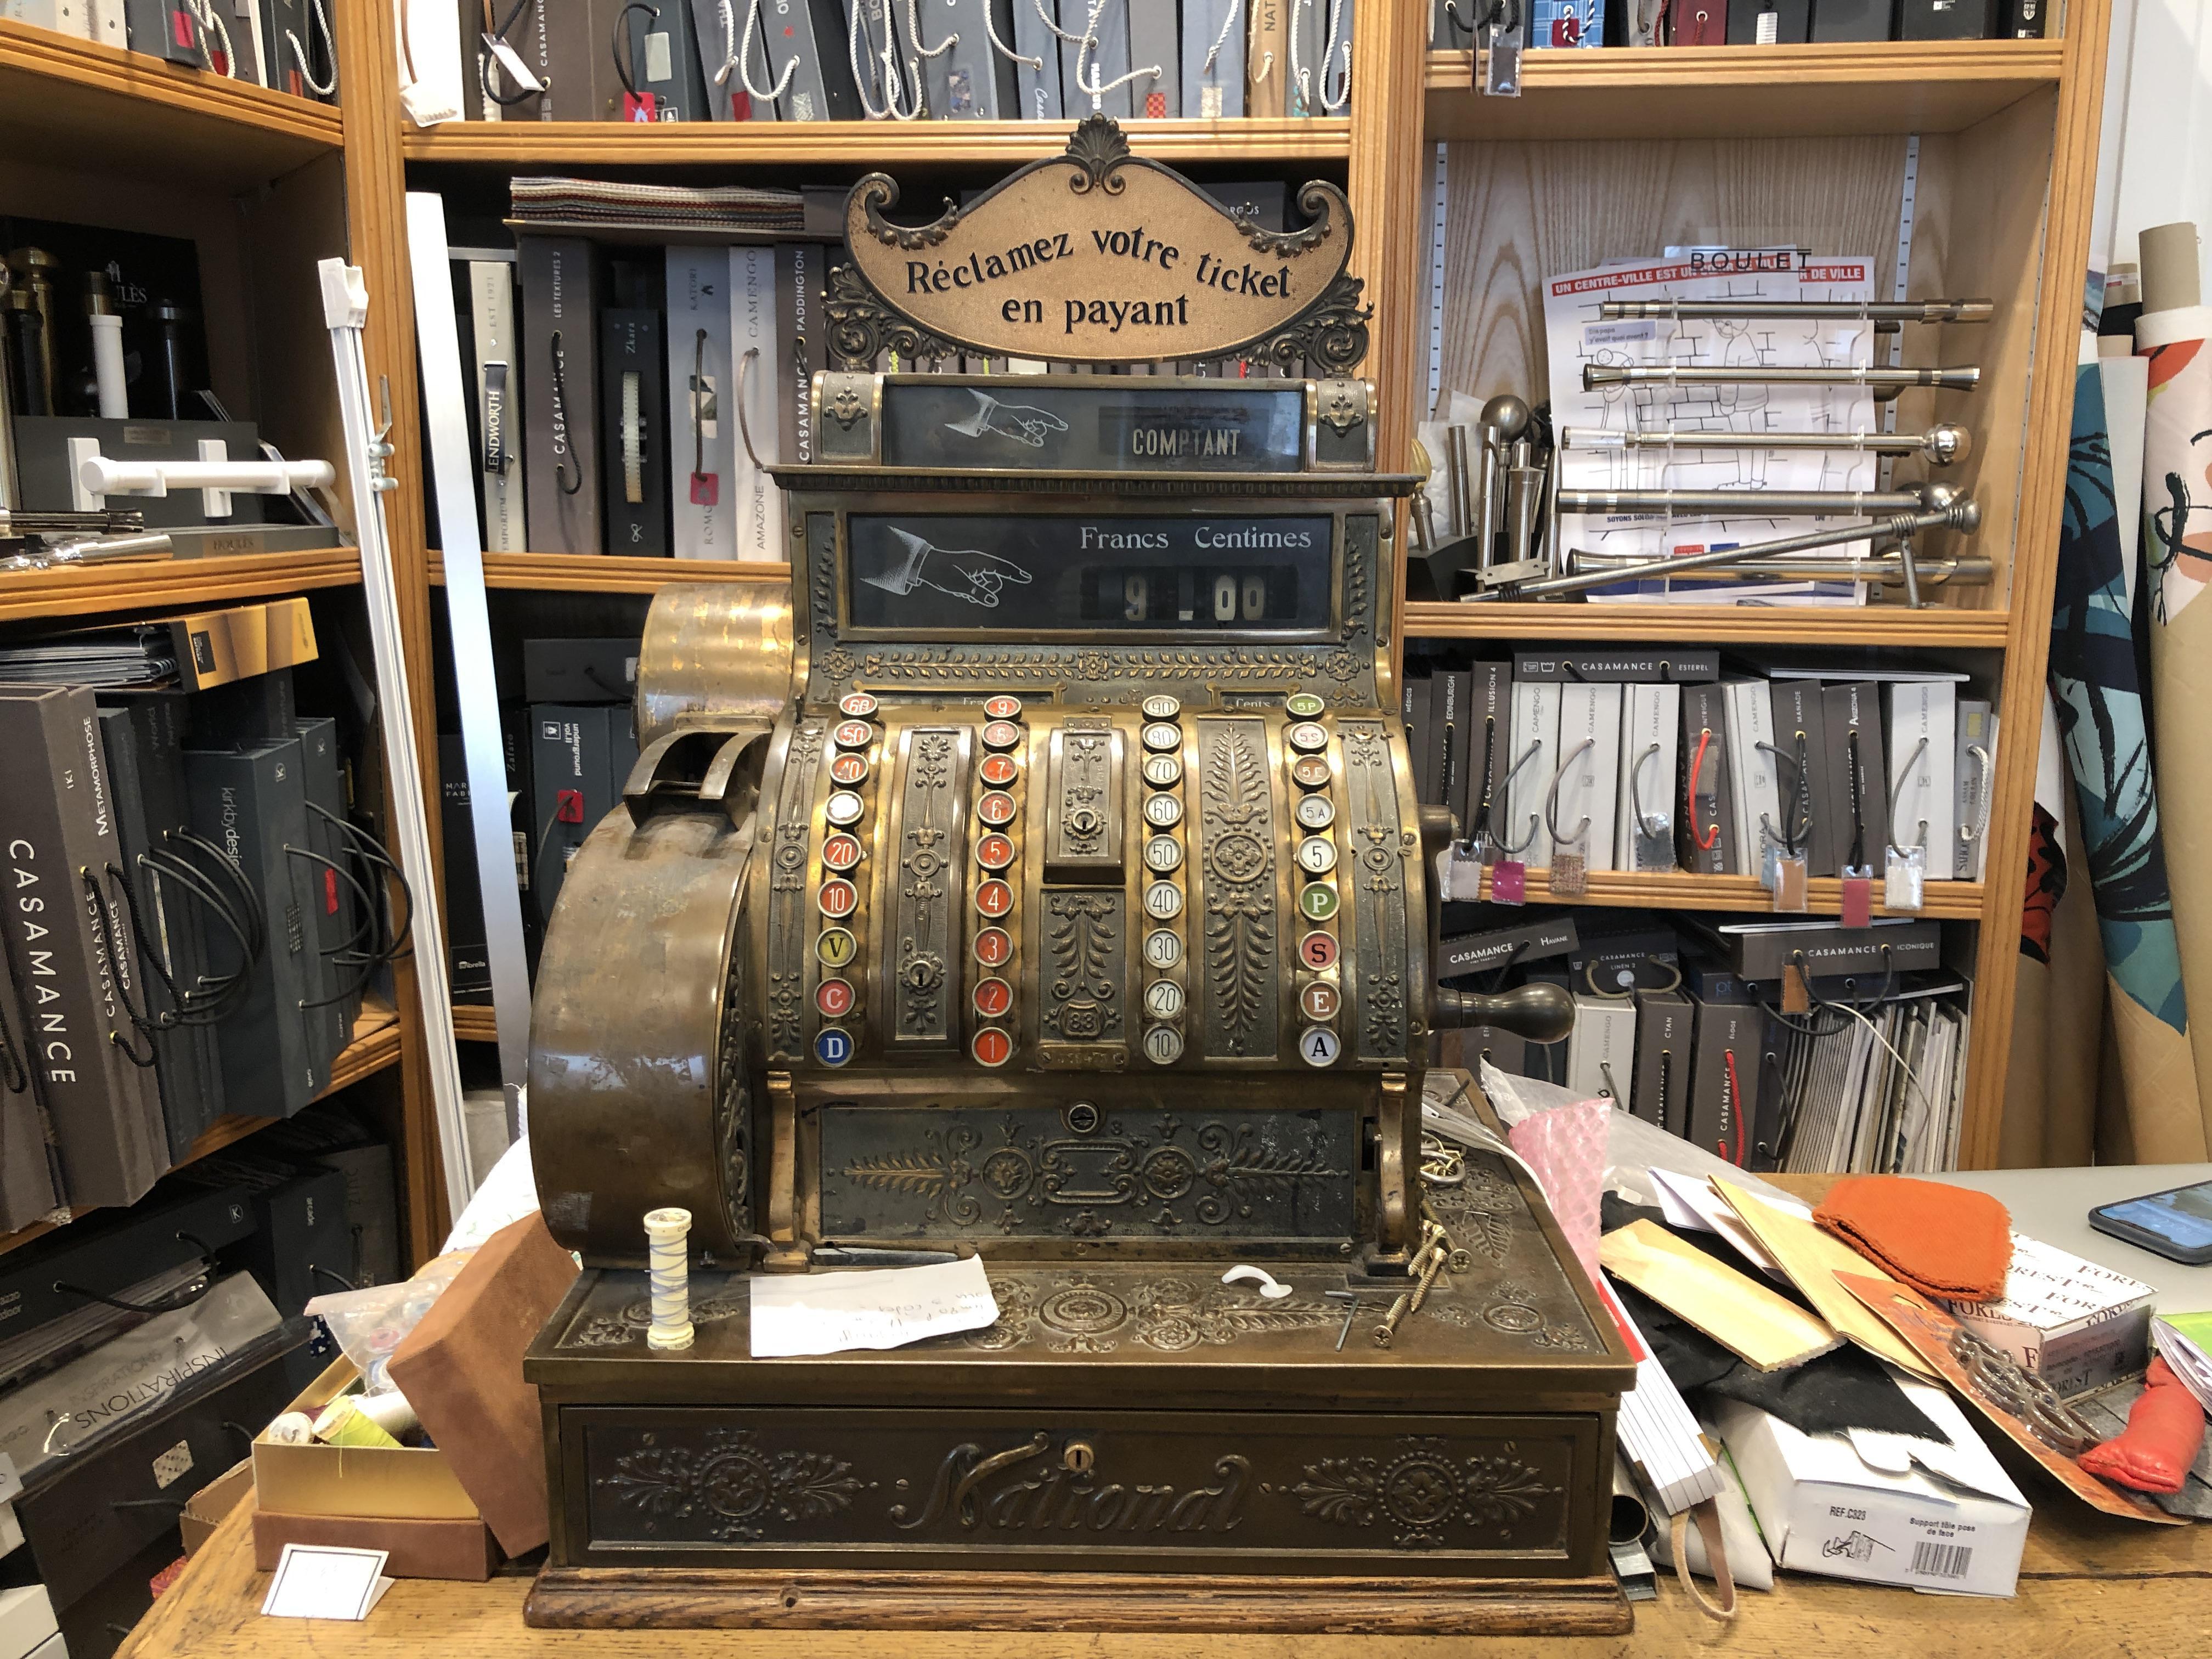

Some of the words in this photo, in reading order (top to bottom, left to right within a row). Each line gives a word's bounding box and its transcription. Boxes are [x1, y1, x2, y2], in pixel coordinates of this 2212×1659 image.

[906, 232, 1074, 295] Réclamez
[1092, 226, 1179, 271] votre
[1196, 251, 1296, 300] ticket
[1691, 252, 1811, 269] BOULET
[1555, 284, 1573, 295] UN
[1575, 272, 1652, 291] CENTRE-VILLE
[1657, 267, 1678, 280] EST
[1812, 269, 1826, 279] DE
[1830, 268, 1861, 279] VILLE
[746, 250, 758, 338] CAMENGO
[797, 250, 805, 332] PADDINGTON
[1002, 298, 1042, 323] en
[1064, 295, 1189, 334] payant
[1132, 428, 1240, 456] COMPTANT
[756, 485, 765, 550] AMAZONE
[1080, 527, 1169, 550] Francs
[1194, 526, 1312, 550] Centimes
[1582, 662, 1654, 671] CASAMANCE
[1679, 663, 1709, 672] ESTEREL
[962, 697, 984, 706] Fra
[1447, 675, 1455, 720] EDINBURGH
[1488, 674, 1496, 713] ILLUSION
[998, 701, 1008, 714] 9
[1153, 702, 1171, 714] 90
[1297, 702, 1316, 711] 5P
[1532, 687, 1541, 733] CAMENGO
[1588, 687, 1596, 733] CAMENGO
[572, 723, 583, 776] underground
[64, 769, 74, 789] IKI
[83, 716, 109, 837] METAMORPHOSE
[996, 761, 1005, 778] 7
[1153, 761, 1172, 780] 70
[991, 800, 1002, 821] 6
[1153, 800, 1173, 821] 60
[1306, 806, 1325, 819] 5A
[832, 842, 852, 862] 20
[991, 842, 1000, 862] 5
[1153, 844, 1173, 865] 50
[1312, 845, 1322, 867] 5
[830, 888, 845, 910] 10
[988, 888, 999, 910] 4
[1152, 889, 1174, 912] 40
[1312, 893, 1328, 913] P
[86, 891, 116, 1017] CASAMANCE
[110, 900, 131, 990] CASAMANCE
[828, 938, 844, 957] V
[988, 937, 998, 960] 3
[1154, 938, 1174, 960] 30
[1312, 943, 1327, 963] S
[1450, 943, 1513, 964] CASAMANCE
[1541, 934, 1568, 946] HAVANE
[1808, 945, 1877, 957] CASAMANCE
[1897, 942, 1935, 951] ICONIQUE
[9, 838, 76, 1084] CASAMANCE
[1600, 952, 1645, 961] CASAMANCE
[826, 988, 843, 1007] C
[988, 986, 998, 1011] 2
[1156, 988, 1176, 1012] 20
[1313, 992, 1330, 1012] E
[827, 1037, 843, 1058] D
[989, 1036, 996, 1058] 1
[1156, 1034, 1171, 1057] 10
[1312, 1037, 1329, 1057] A
[1604, 1015, 1612, 1059] CAMENGO
[74, 1346, 229, 1429] INSPIRATIONS
[889, 1431, 1252, 1533] National
[1910, 1517, 1939, 1527] Support
